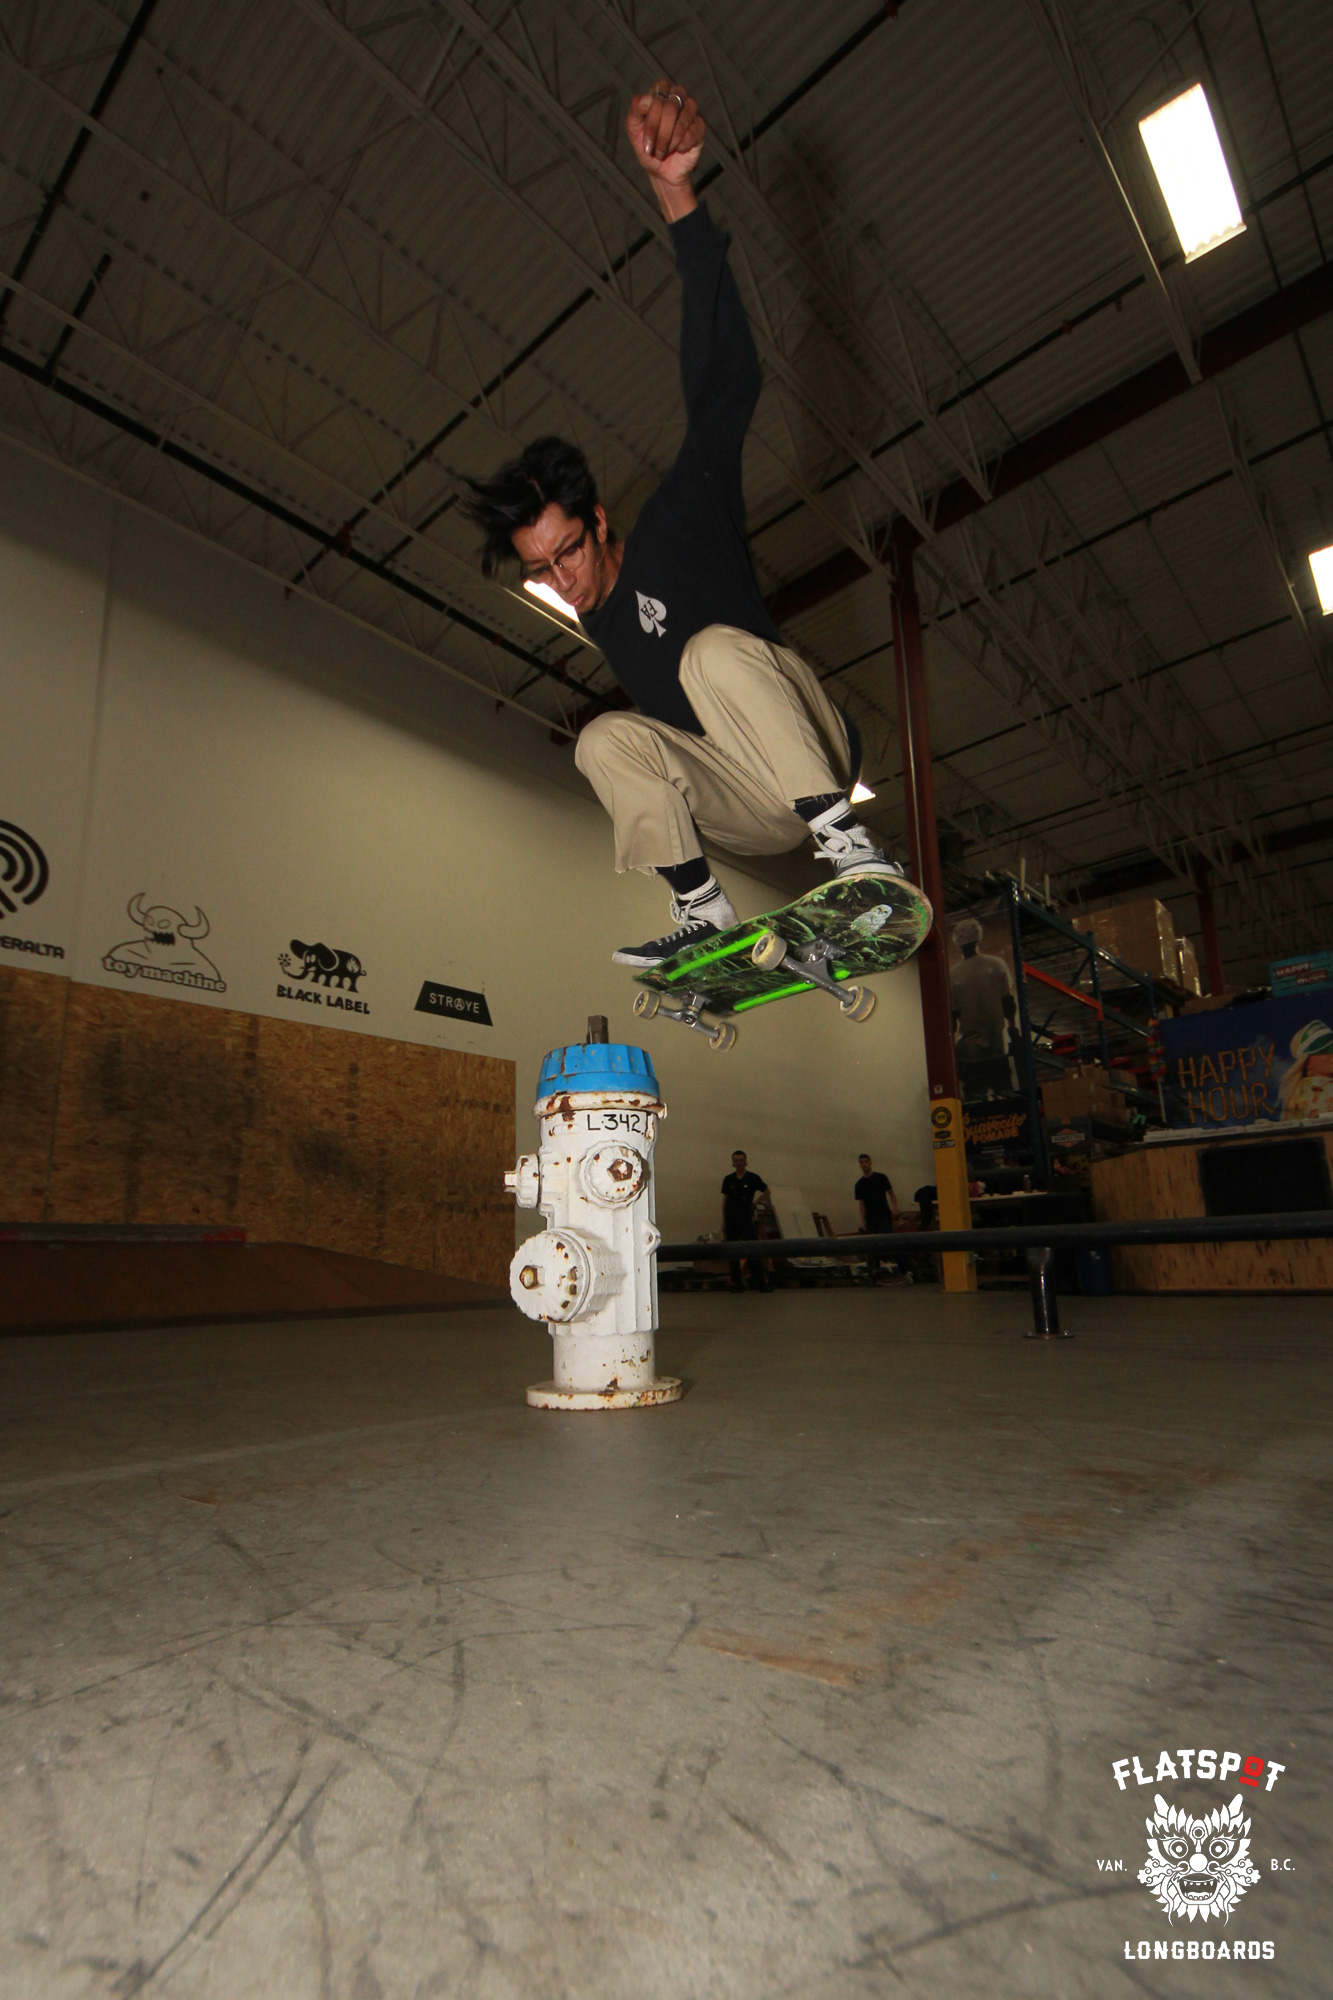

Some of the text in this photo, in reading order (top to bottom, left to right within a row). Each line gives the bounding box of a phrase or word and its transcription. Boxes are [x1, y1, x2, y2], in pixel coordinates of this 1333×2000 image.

[0, 936, 65, 960] ERALTA
[102, 955, 227, 993] toy machine
[276, 984, 371, 1015] BLACK LABEL
[428, 992, 480, 1014] STRAYE
[1177, 1042, 1275, 1089] HAPPY
[1187, 1082, 1276, 1125] HOUR
[972, 1126, 1020, 1145] POMADE
